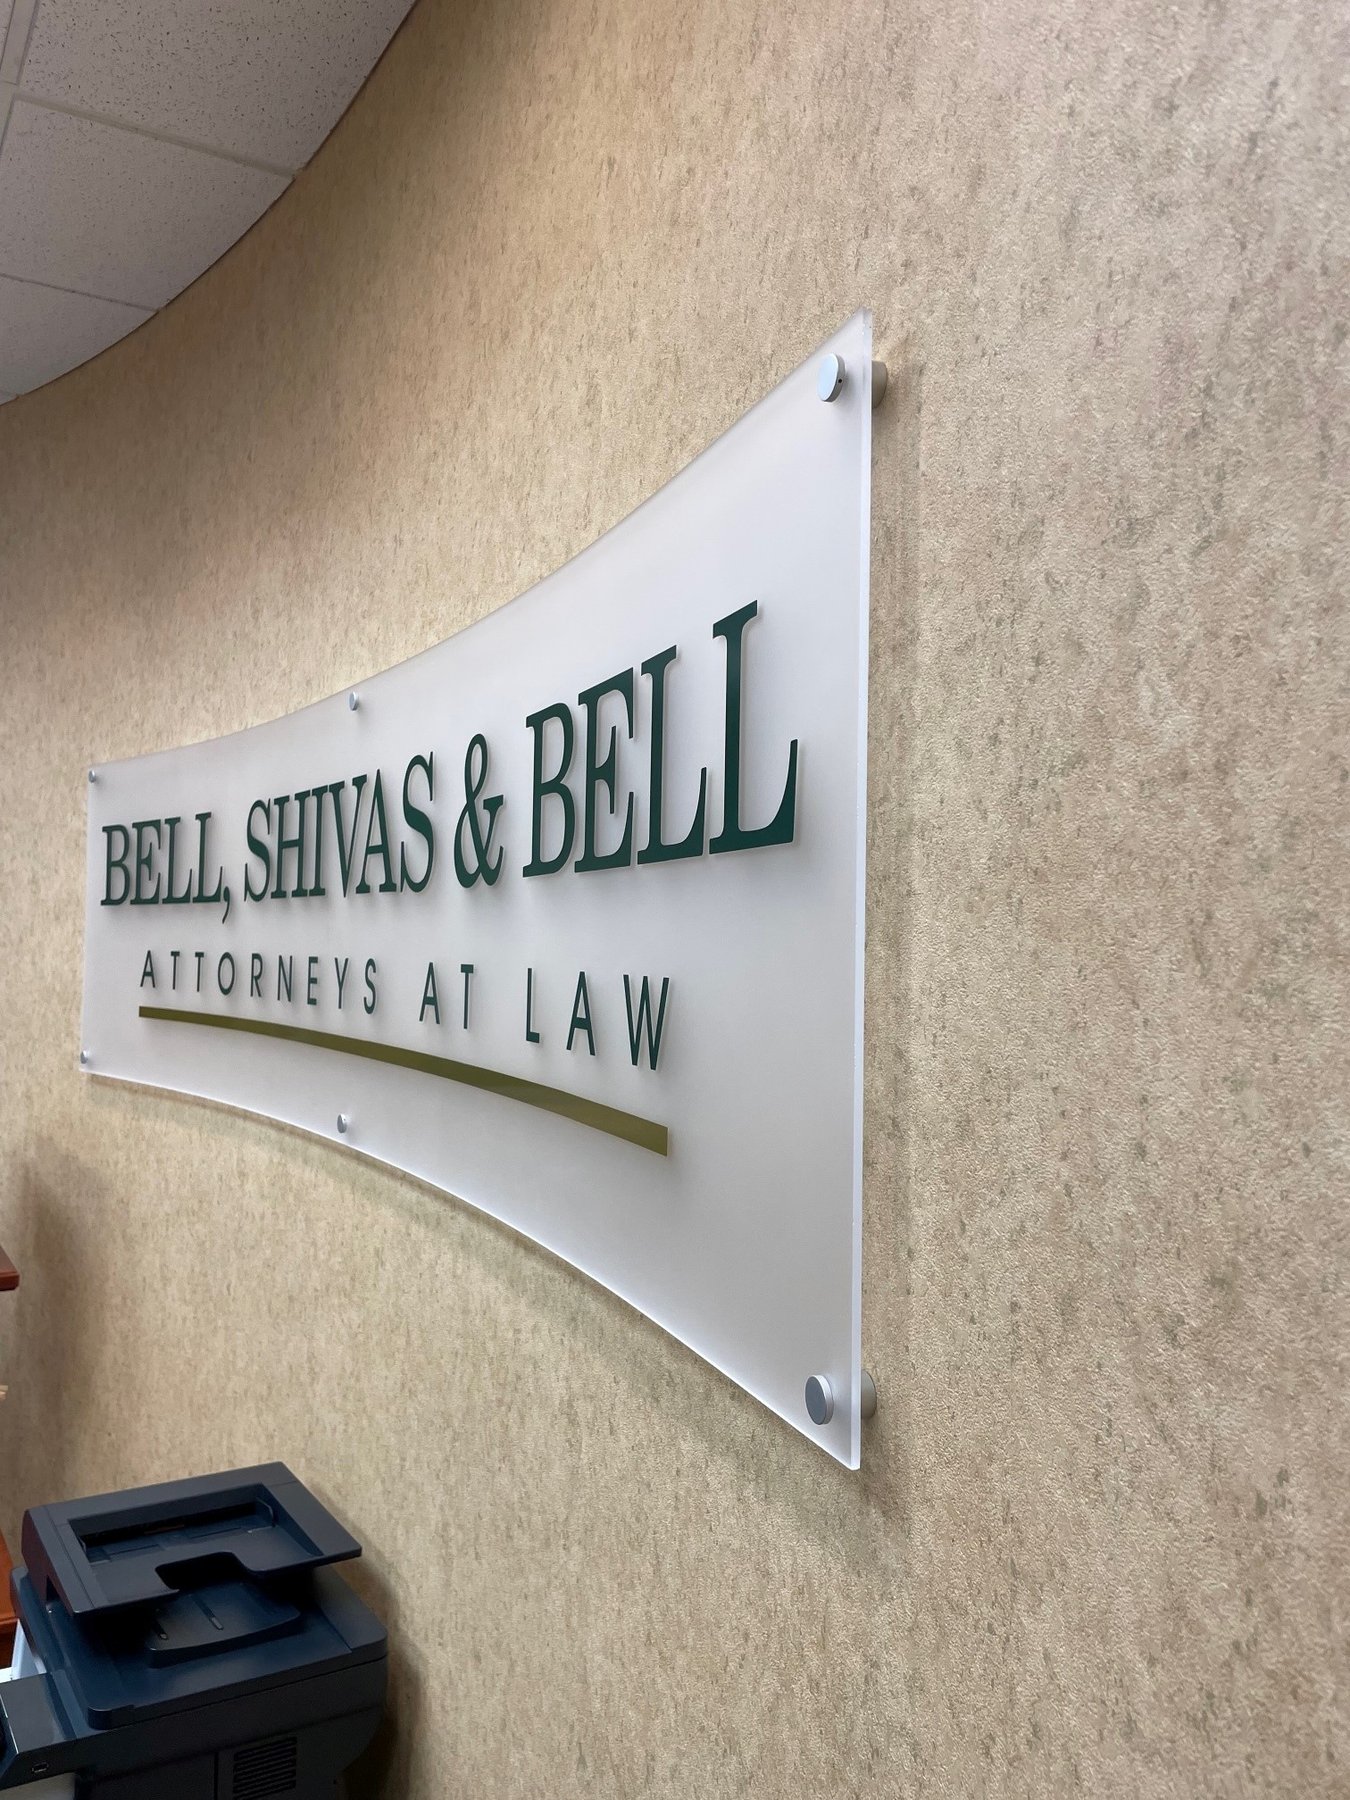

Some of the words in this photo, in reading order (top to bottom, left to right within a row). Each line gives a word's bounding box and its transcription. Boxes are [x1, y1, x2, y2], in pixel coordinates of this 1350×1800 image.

[100, 812, 231, 923] BELL,
[244, 750, 434, 903] SHIVAS
[453, 733, 504, 888] &
[522, 600, 798, 879] BELL
[140, 950, 377, 1015] ATTORNEYS
[418, 961, 475, 1030] AT
[526, 967, 670, 1071] LAW
